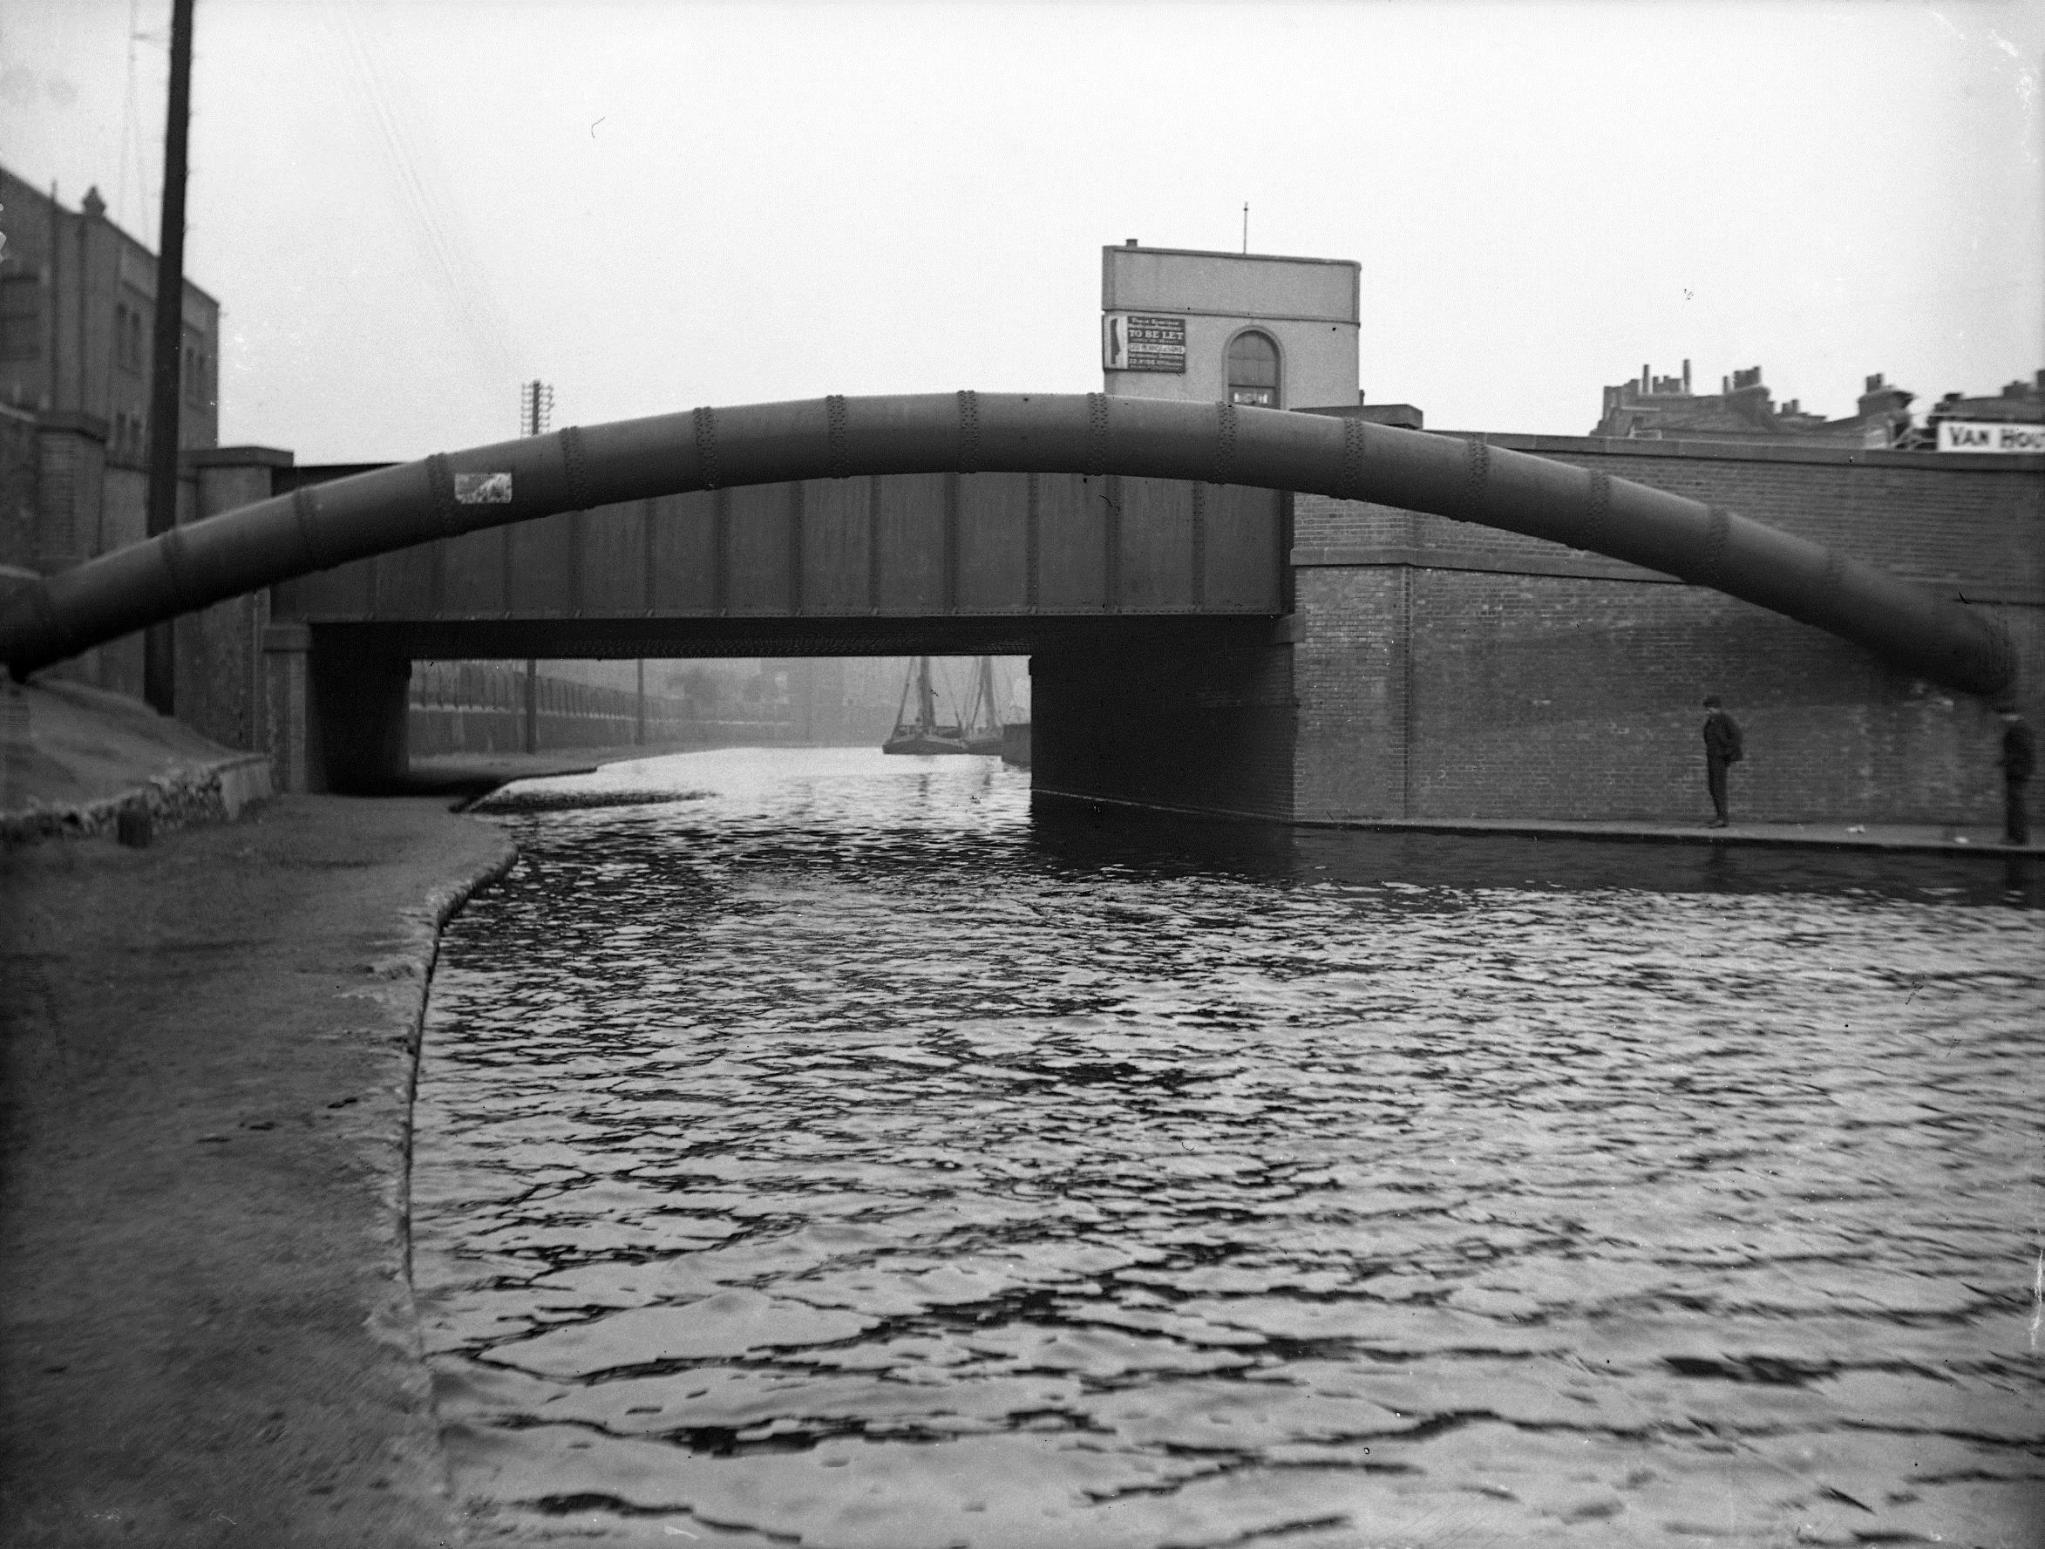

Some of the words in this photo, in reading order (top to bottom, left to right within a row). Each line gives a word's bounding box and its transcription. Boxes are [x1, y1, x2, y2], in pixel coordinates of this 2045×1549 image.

[1129, 329, 1142, 338] TO
[1144, 330, 1159, 339] BE
[1162, 331, 1184, 340] LET
[1949, 426, 1990, 446] VAN
